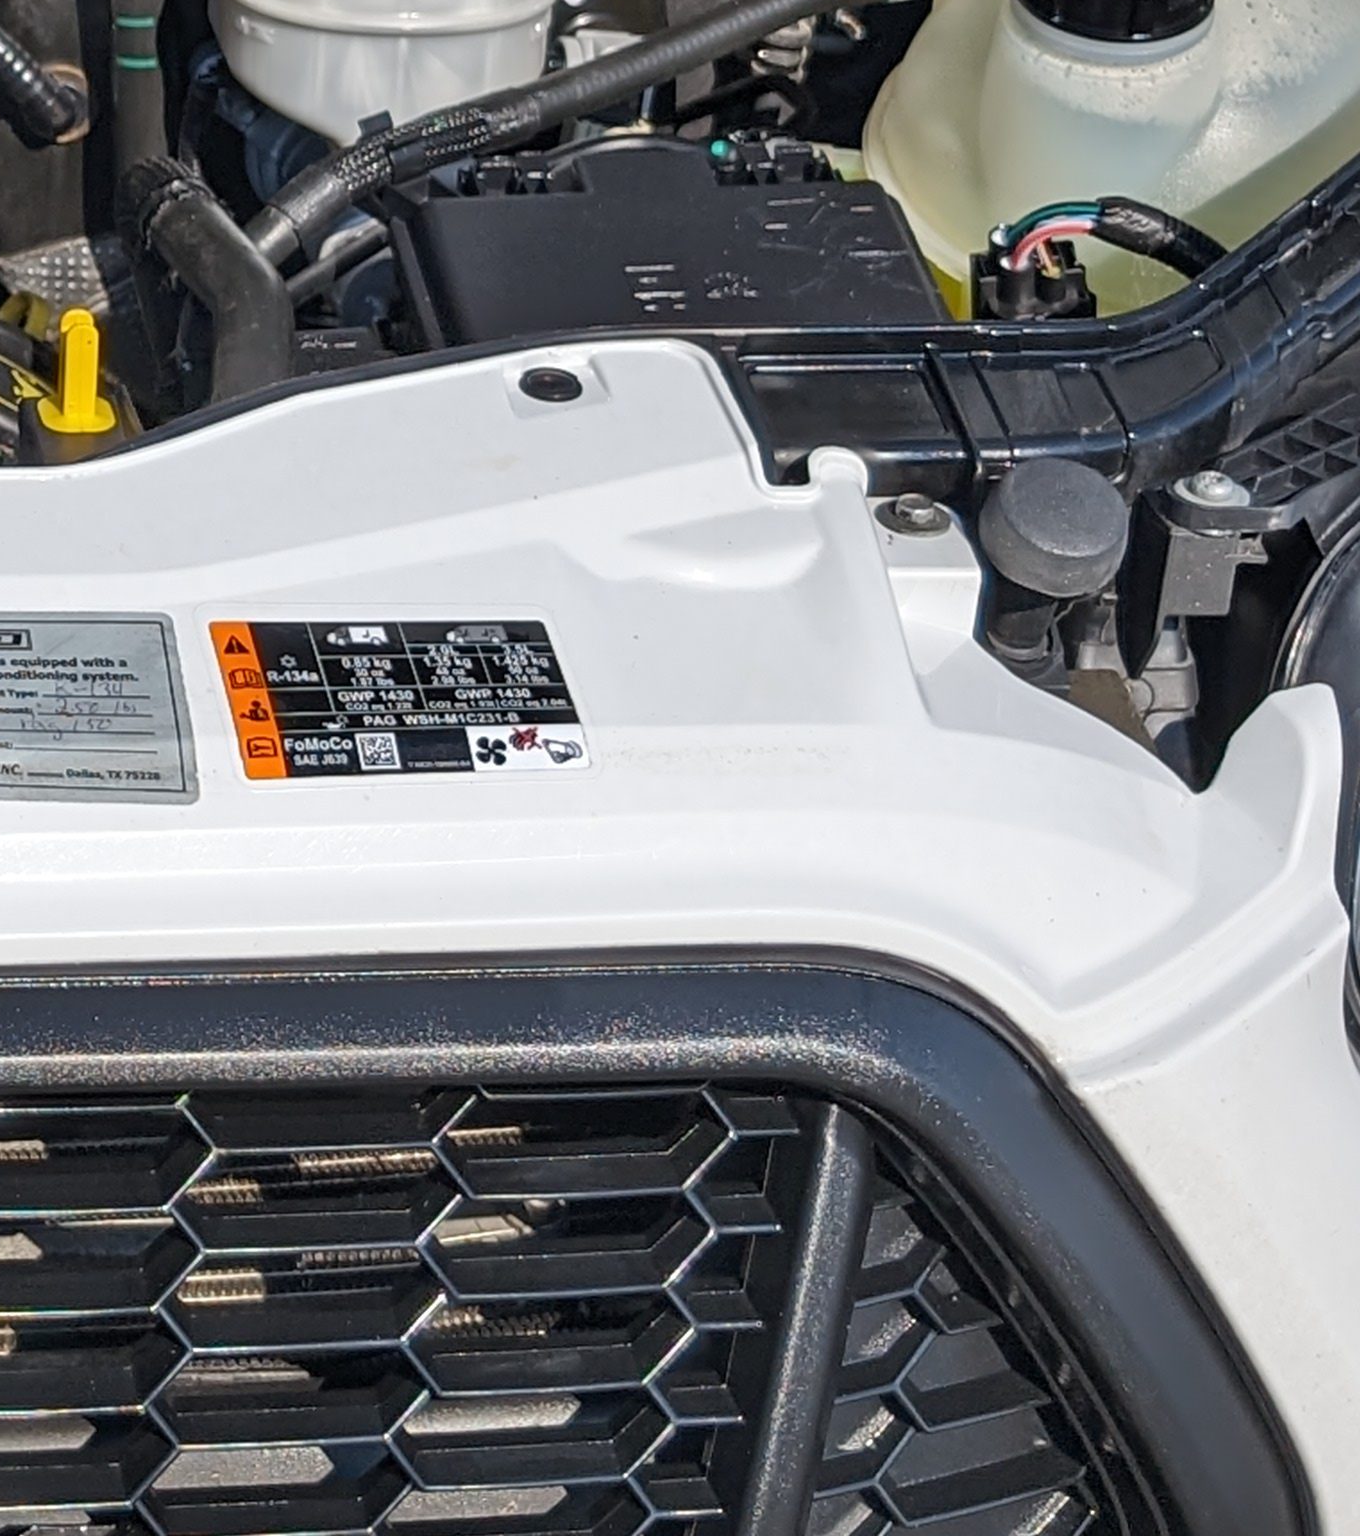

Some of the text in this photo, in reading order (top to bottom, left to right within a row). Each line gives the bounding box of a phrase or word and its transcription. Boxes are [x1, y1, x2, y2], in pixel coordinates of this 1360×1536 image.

[10, 656, 78, 669] equipped
[81, 657, 115, 668] with
[119, 659, 128, 668] a
[341, 657, 392, 671] 0.85 kg
[454, 655, 472, 669] kg
[531, 654, 550, 668] kg
[82, 672, 138, 683] system.
[266, 670, 319, 683] R-134a
[7, 688, 38, 699] Type:
[338, 689, 414, 702] GWP 1430
[455, 687, 531, 700] GWP 1430
[363, 715, 398, 726] PAG
[284, 736, 353, 752] FoMoCo
[293, 754, 320, 766] SAE
[66, 768, 105, 780] Dallas,
[107, 770, 122, 780] TX
